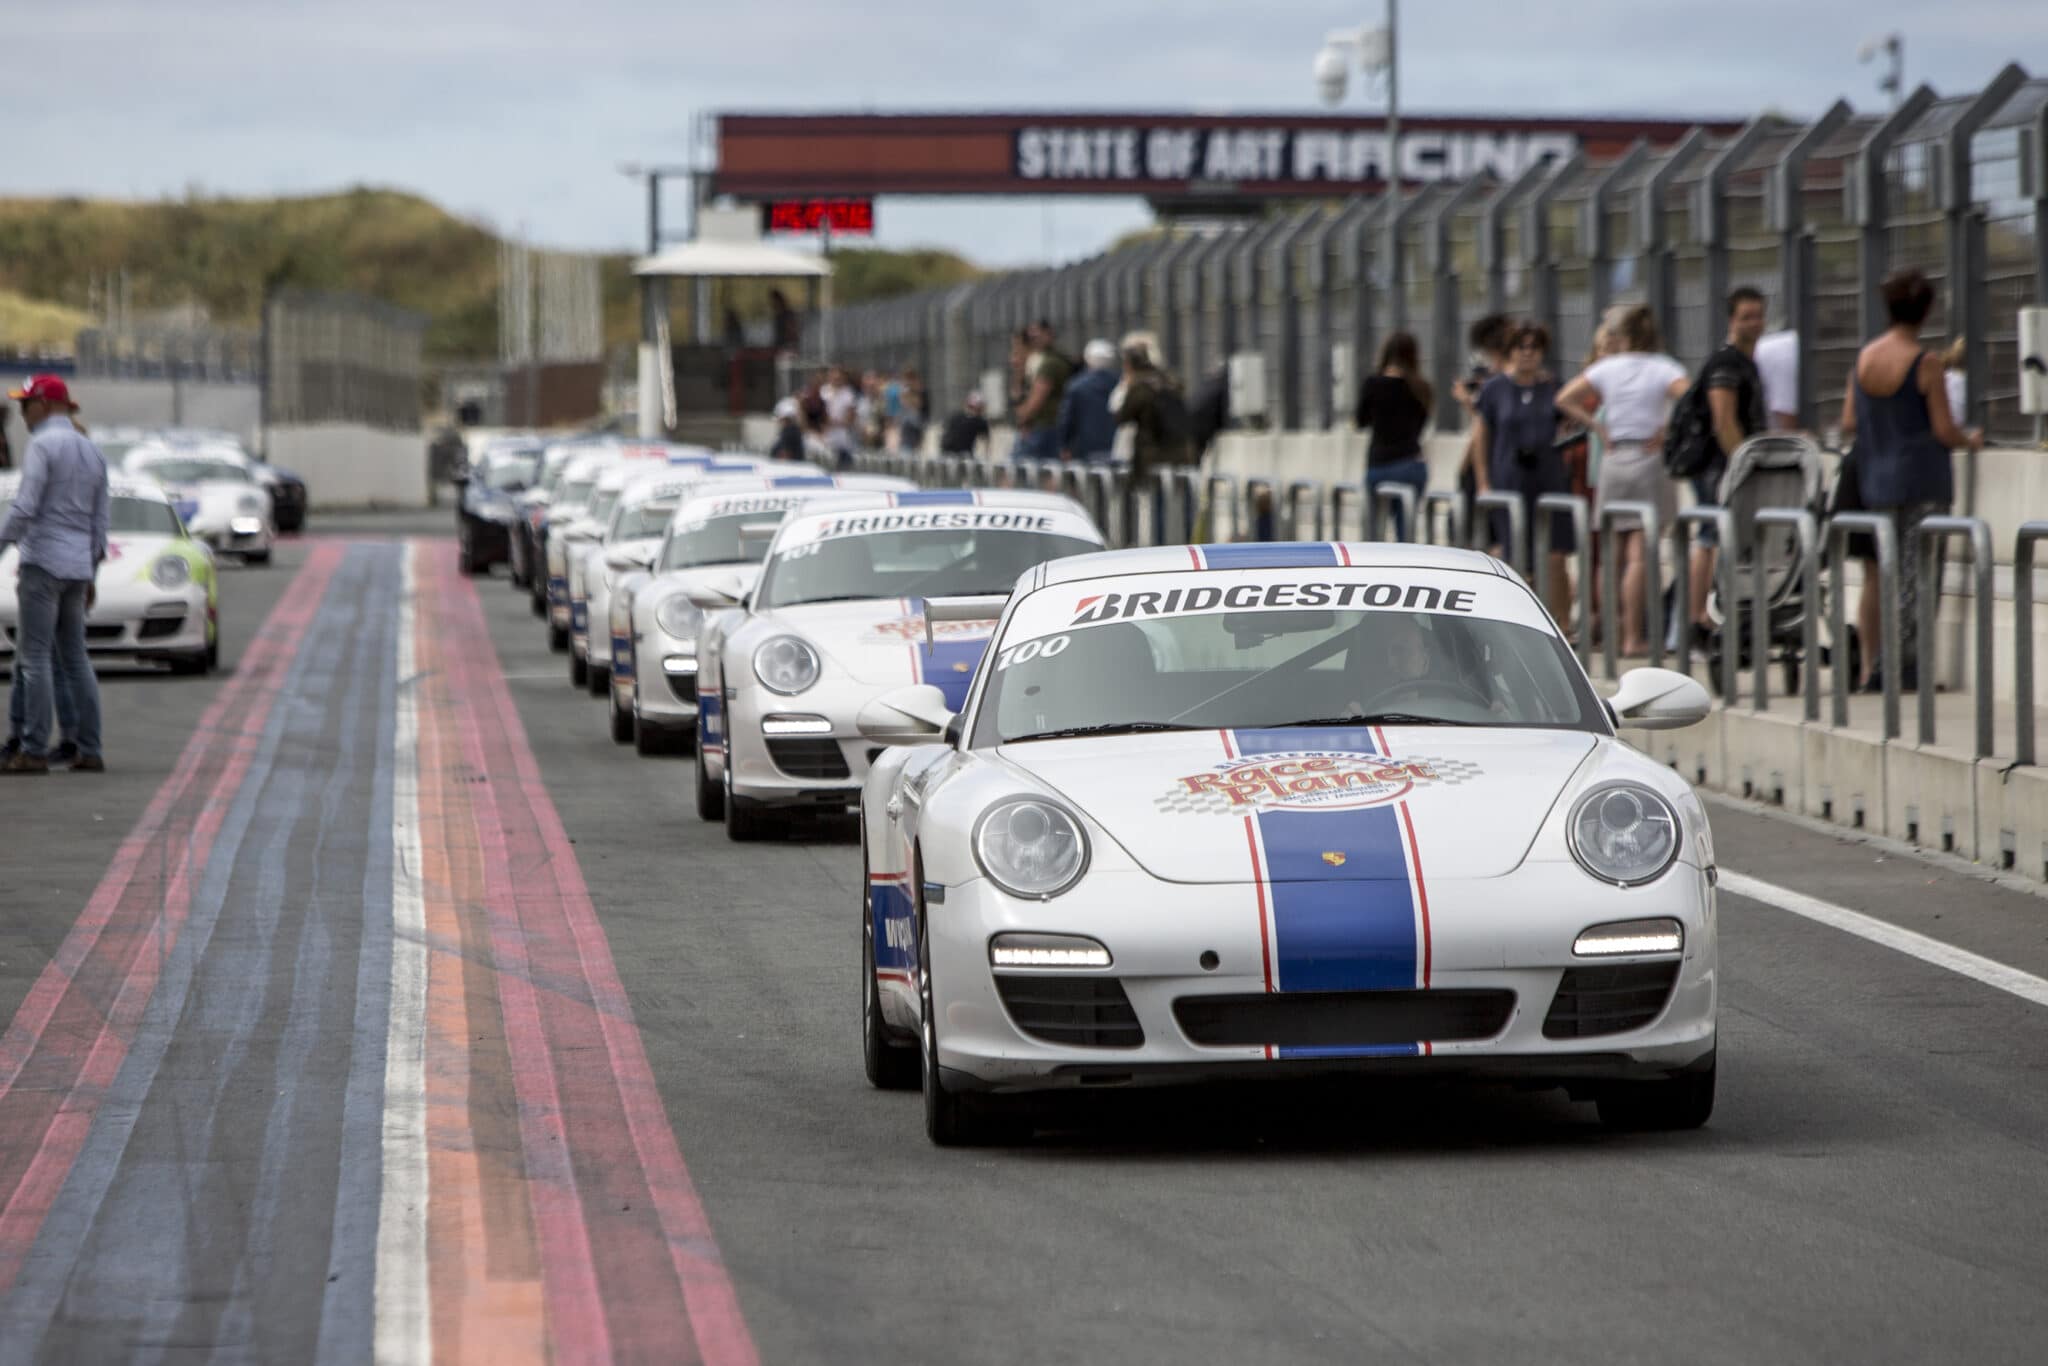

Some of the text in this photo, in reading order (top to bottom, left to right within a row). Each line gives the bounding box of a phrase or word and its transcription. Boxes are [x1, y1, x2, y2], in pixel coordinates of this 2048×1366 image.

[1018, 128, 1138, 180] STATE
[1147, 128, 1198, 180] OF
[1205, 128, 1284, 181] ART
[817, 513, 1055, 538] BRIDGESTONE
[1069, 583, 1478, 627] BRIDGESTONE
[997, 635, 1071, 671] 100
[1178, 758, 1339, 794] Race
[1222, 761, 1440, 806] Planet
